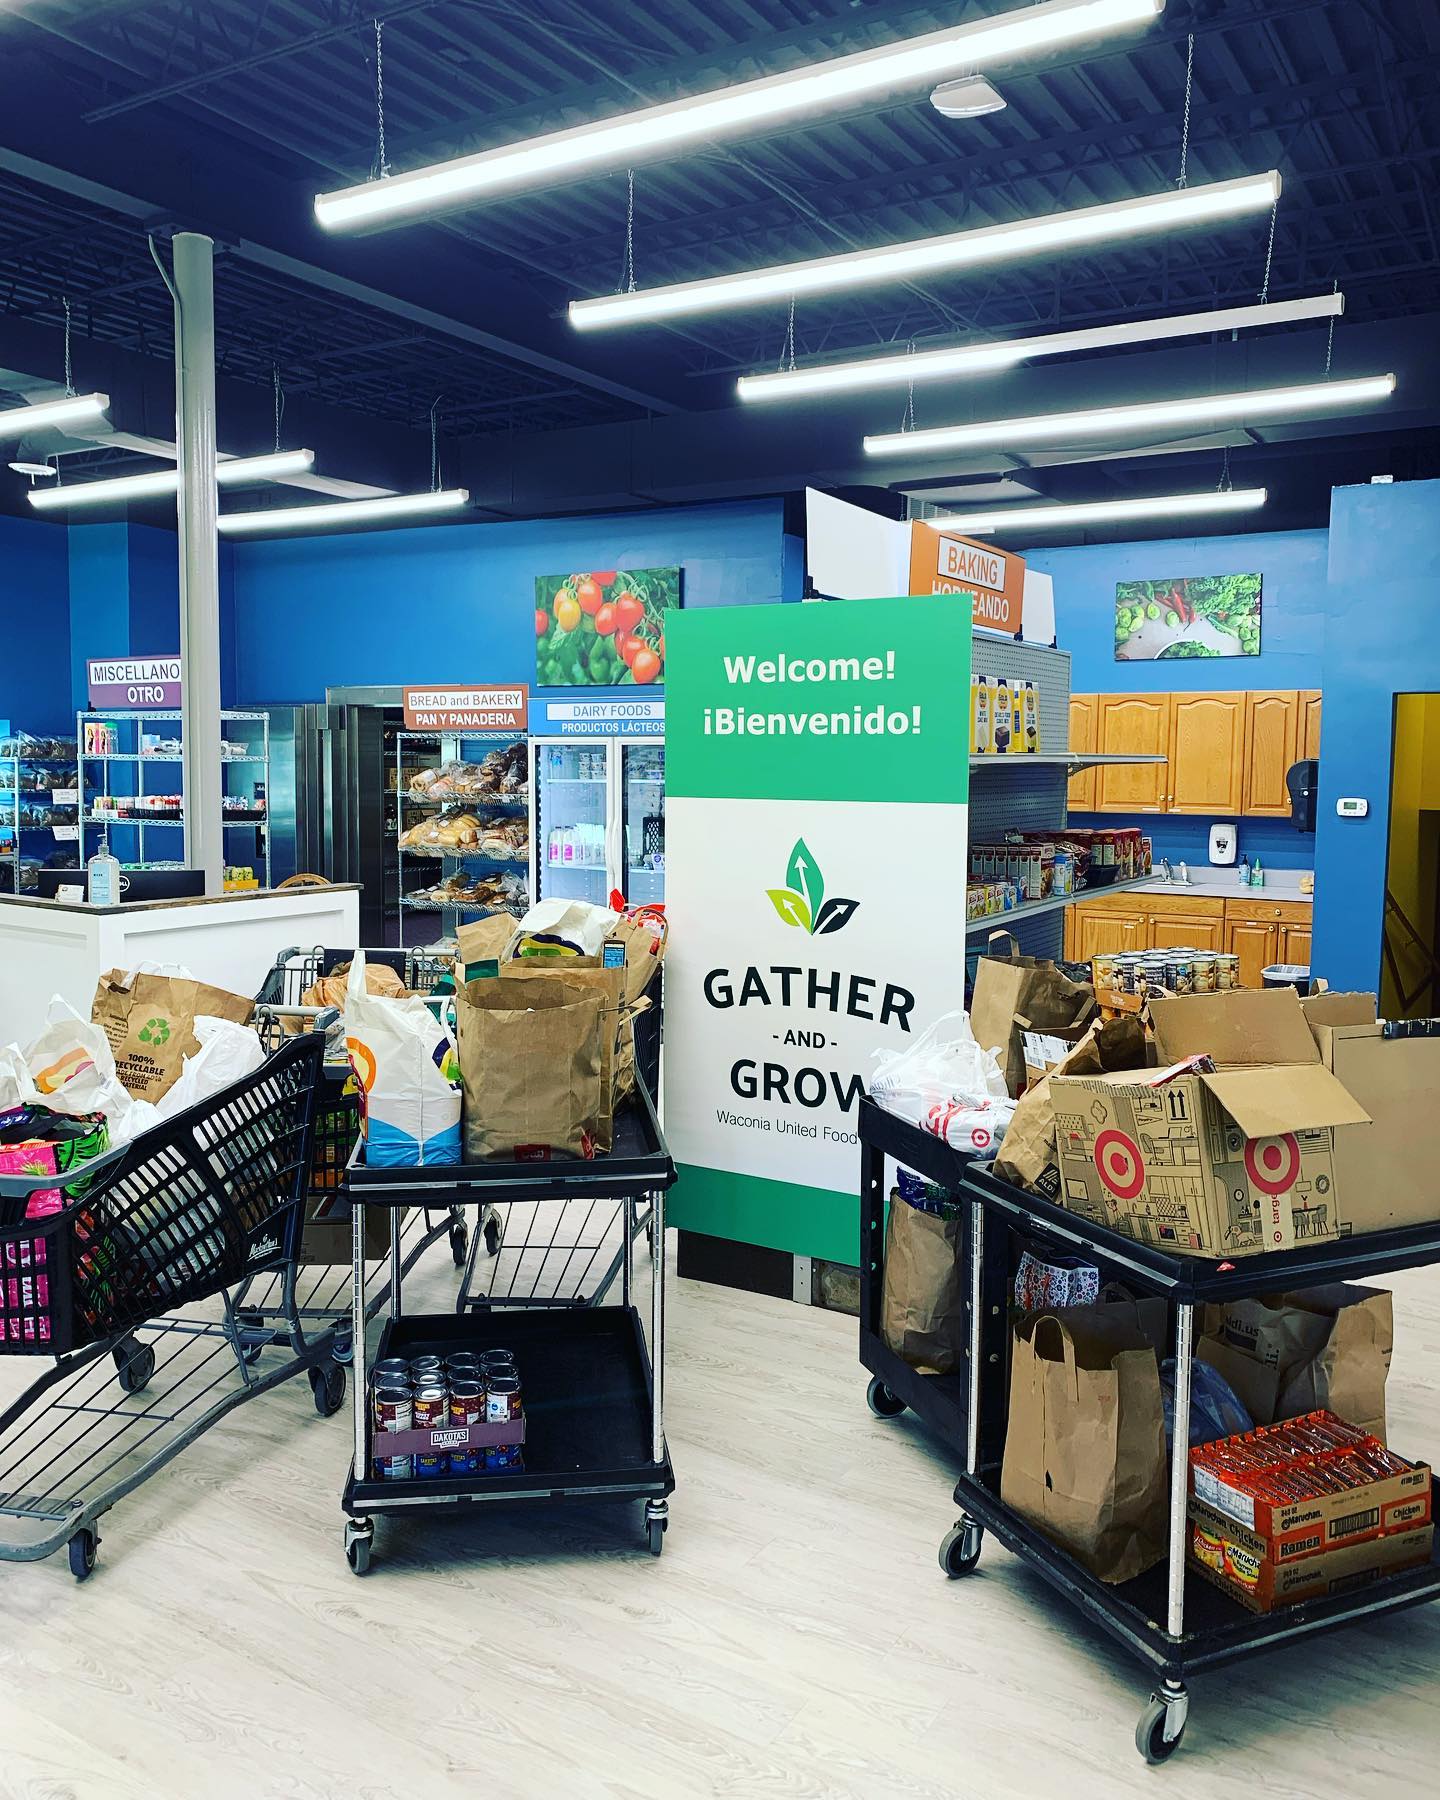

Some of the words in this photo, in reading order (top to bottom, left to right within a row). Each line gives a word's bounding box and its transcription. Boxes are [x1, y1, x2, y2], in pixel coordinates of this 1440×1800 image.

[948, 546, 998, 585] BAKING
[94, 663, 180, 682] MISCELLANO
[723, 651, 896, 683] Welcome!
[127, 685, 164, 703] OTRO
[410, 695, 447, 707] BREAD
[450, 696, 469, 706] and
[472, 693, 520, 706] BAKERY
[415, 714, 437, 726] PAN
[439, 714, 447, 725] Y
[449, 713, 516, 726] PANADERIA
[573, 706, 607, 717] DAIRY
[610, 705, 652, 716] FOODS
[703, 705, 922, 736] ¡Bienvenido!
[561, 722, 619, 733] PRODUCTOS
[703, 966, 916, 1033] GATHER
[783, 1029, 826, 1049] AND
[115, 1060, 166, 1076] RECYCLABLE
[128, 1053, 155, 1066] 100%
[120, 1075, 149, 1085] RECYCLED
[730, 1058, 867, 1113] GROW
[716, 1109, 771, 1131] Waconia
[776, 1119, 817, 1139] United
[823, 1126, 858, 1145] Food
[1271, 1194, 1281, 1225] targe
[1393, 1505, 1421, 1518] Chicken
[1229, 1523, 1266, 1553] Chicken
[1280, 1536, 1321, 1557] Ramen
